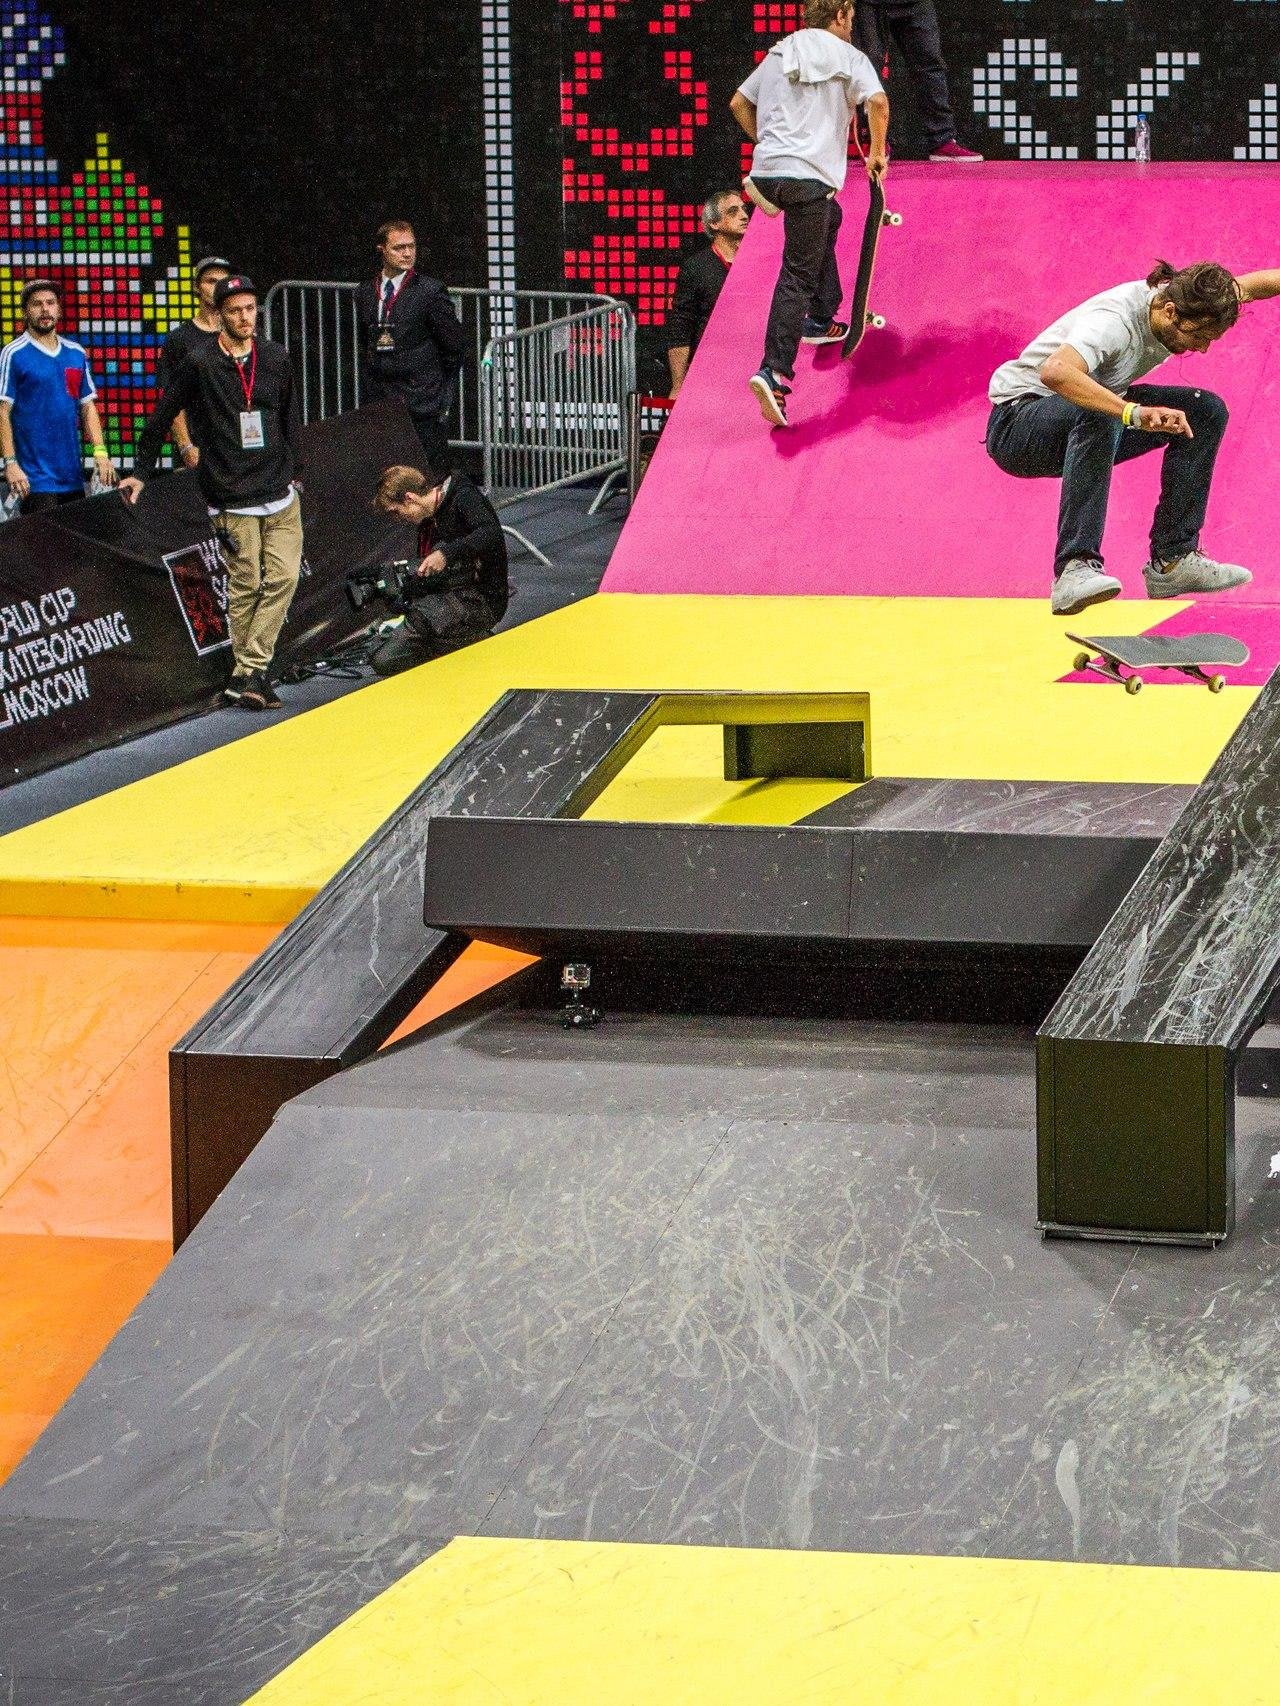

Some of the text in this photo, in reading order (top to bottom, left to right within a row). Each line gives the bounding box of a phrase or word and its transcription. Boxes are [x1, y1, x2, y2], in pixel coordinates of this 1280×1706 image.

[40, 586, 76, 627] CUP
[0, 611, 132, 690] KATEBOARDING
[4, 665, 90, 724] MOSCOW
